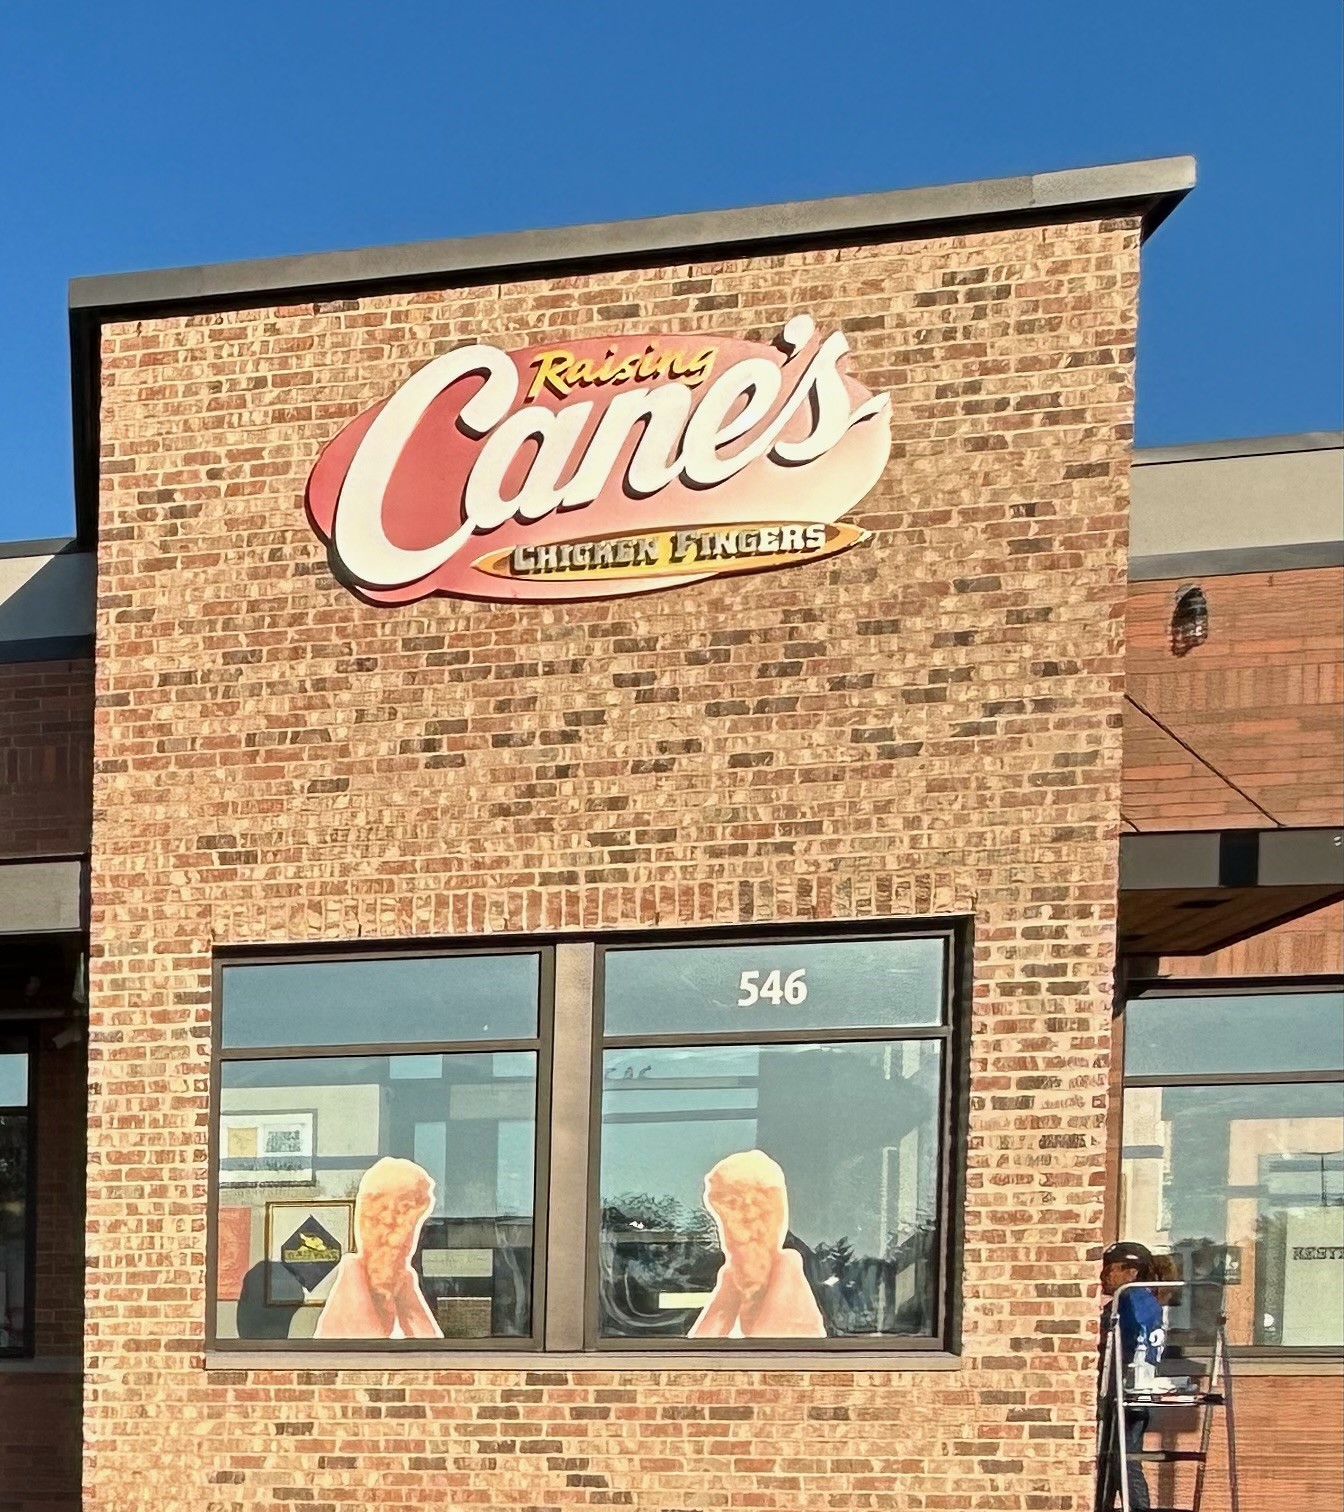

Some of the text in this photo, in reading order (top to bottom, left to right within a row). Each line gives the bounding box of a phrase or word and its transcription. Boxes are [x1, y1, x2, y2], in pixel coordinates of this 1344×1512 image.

[528, 339, 719, 402] Raising
[334, 314, 891, 588] Cane's
[512, 523, 827, 575] CHICKEN FINGERS
[737, 968, 808, 1007] 546
